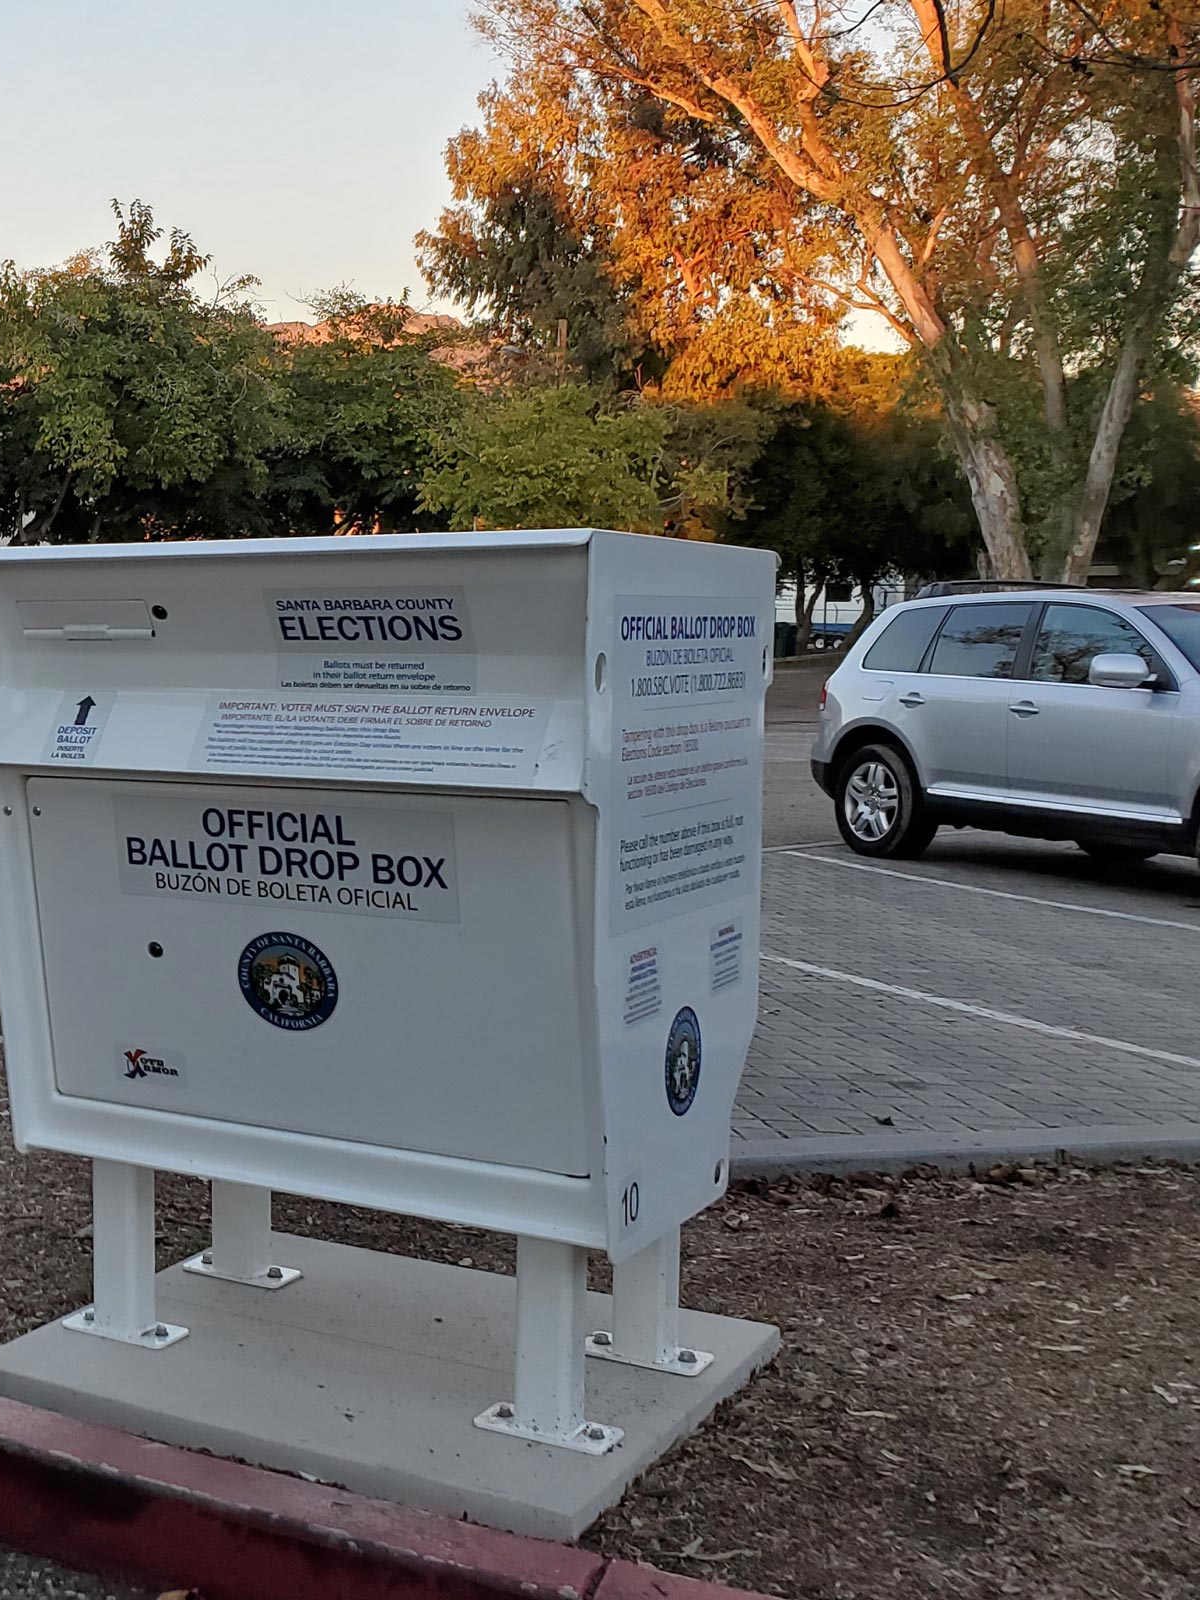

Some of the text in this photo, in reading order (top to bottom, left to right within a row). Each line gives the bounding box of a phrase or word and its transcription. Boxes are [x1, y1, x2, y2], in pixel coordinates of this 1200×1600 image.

[275, 598, 454, 611] SANTA BARBARA COUNTY
[278, 615, 463, 641] ELECTIONS
[621, 615, 756, 641] OFFICIAL BALLOT DROP BOX
[323, 660, 425, 671] Ballots must be returned
[645, 646, 734, 666] BUZÓN DE BOLETA OFICIAL
[293, 681, 318, 689] boletas
[319, 681, 342, 690] deben
[354, 682, 389, 690] devueltas
[410, 683, 431, 691] sobre
[432, 683, 442, 691] de
[443, 684, 471, 692] retorno
[313, 671, 436, 682] in their ballot return envelope
[218, 702, 536, 718] IMPORTANT: VOTER MUST SIGN THE BALLOT RETURN ENVELOPE
[57, 726, 98, 735] DEPOSIT
[274, 714, 297, 723] EL/LA
[298, 715, 336, 724] VOTANTE
[337, 716, 358, 724] DEBE
[360, 717, 392, 725] FIRMAR
[405, 718, 433, 726] SOBRE
[435, 719, 447, 727] DE
[449, 719, 492, 728] RETORNO
[57, 735, 93, 744] BALLOT
[201, 807, 356, 847] OFFICIAL
[620, 839, 638, 853] Please
[639, 834, 648, 850] call
[649, 832, 658, 847] the
[659, 828, 680, 844] number
[681, 825, 696, 839] above
[126, 836, 448, 890] BALLOT DROP BOX
[620, 854, 652, 872] functioning
[669, 845, 682, 860] been
[155, 872, 419, 911] BUZÓN DE BOLETA OFICIAL
[256, 937, 269, 948] OF
[271, 935, 306, 950] SANTA
[307, 946, 336, 998] BARBARA
[260, 1007, 324, 1028] CALIFORNIA
[621, 1181, 639, 1227] 10
